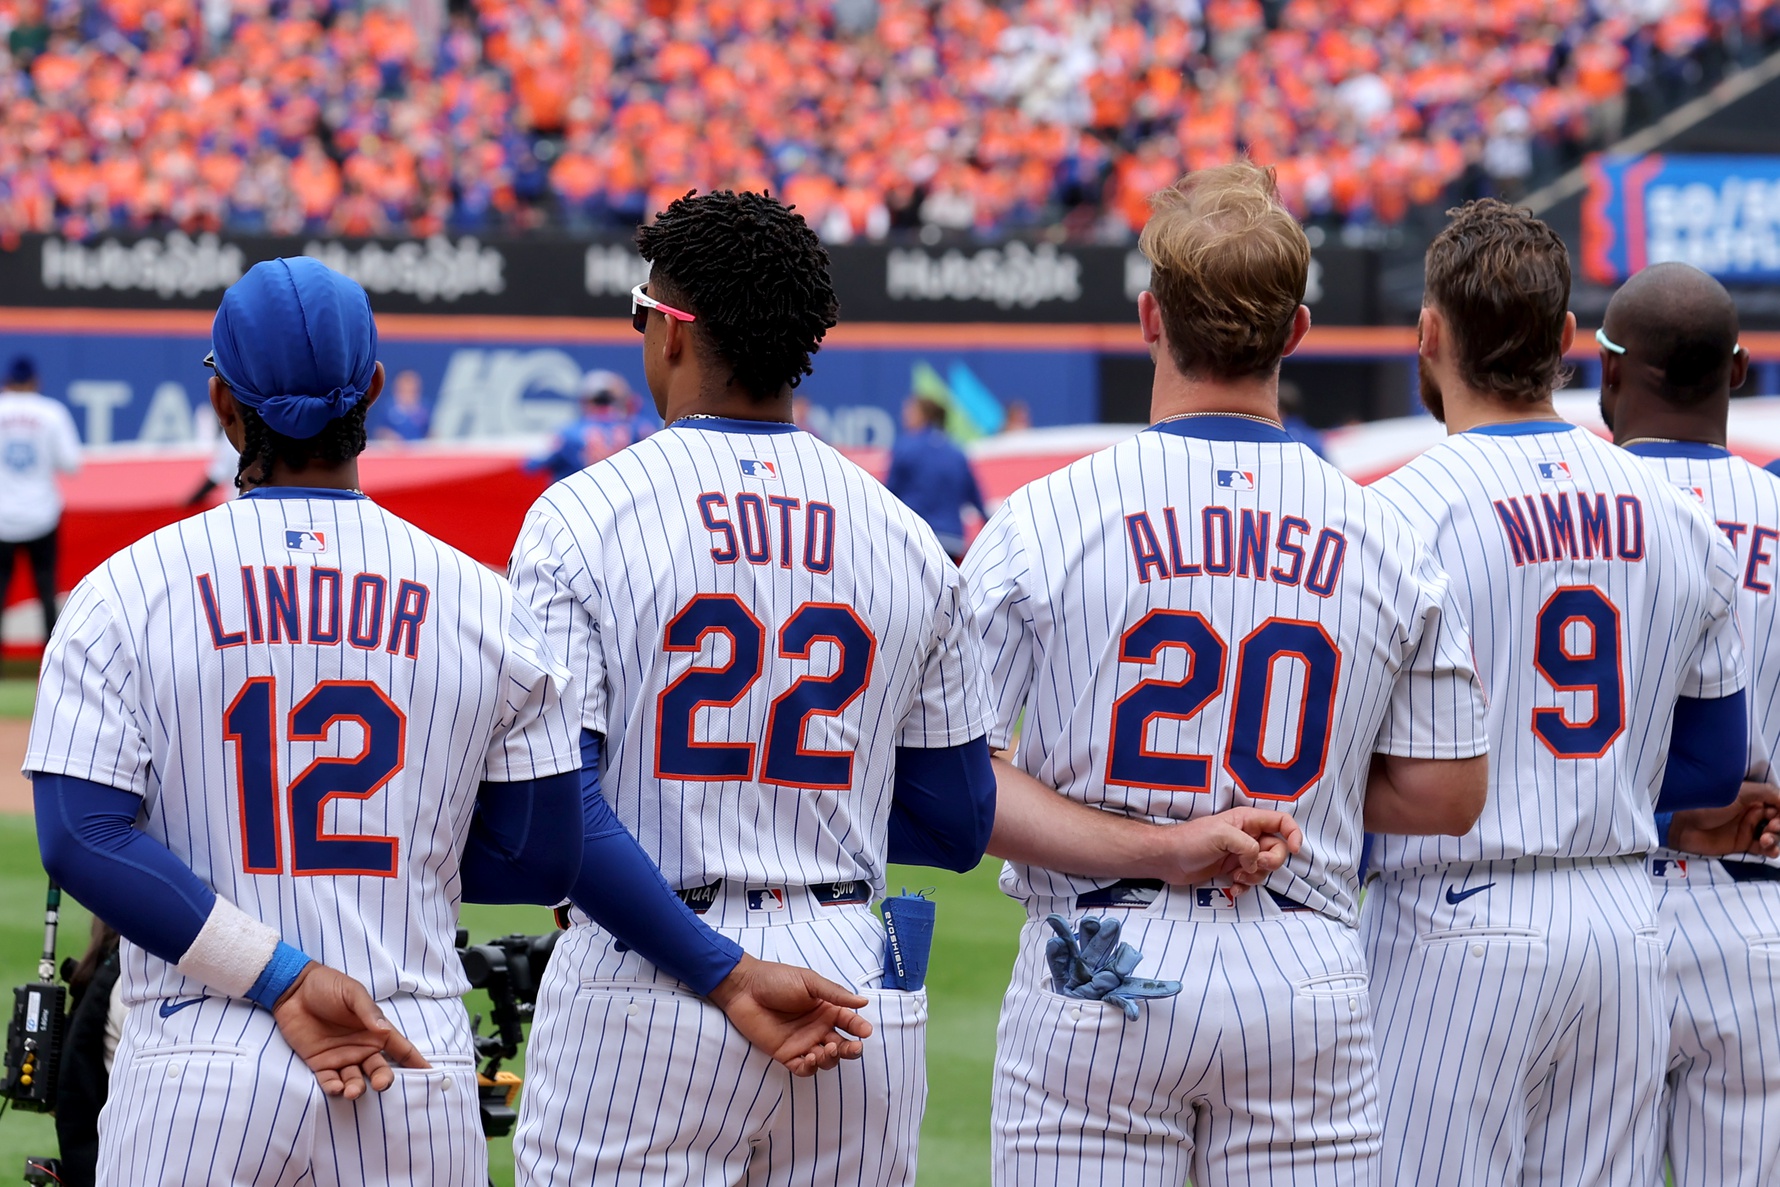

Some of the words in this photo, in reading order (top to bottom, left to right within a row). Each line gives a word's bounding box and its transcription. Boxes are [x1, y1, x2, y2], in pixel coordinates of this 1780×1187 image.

[41, 229, 247, 299] HubSpot
[886, 240, 1082, 309] HubSpot
[697, 492, 835, 575] SOTO
[1125, 505, 1348, 598] ALONSO
[1493, 492, 1644, 567] NIMMO
[196, 565, 430, 660] LINDOR
[654, 593, 877, 790] 22
[1105, 608, 1342, 802] 20
[1531, 584, 1626, 759] 9
[223, 675, 406, 878] 12
[884, 911, 905, 977] EVOSHIELD
